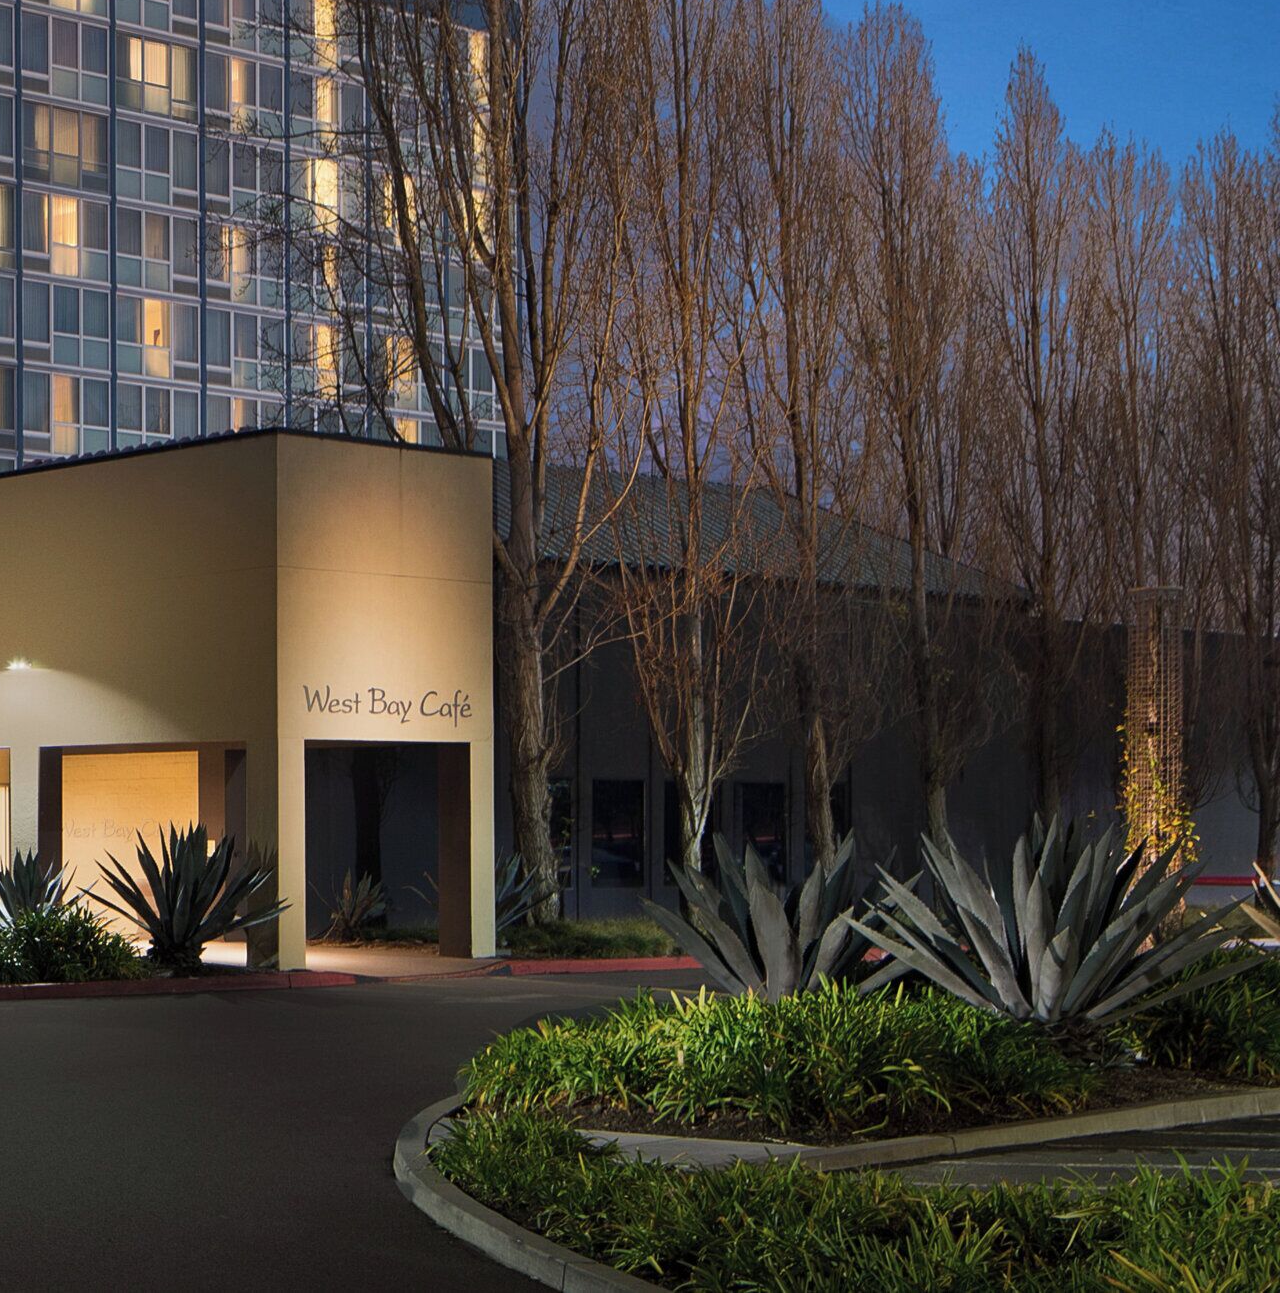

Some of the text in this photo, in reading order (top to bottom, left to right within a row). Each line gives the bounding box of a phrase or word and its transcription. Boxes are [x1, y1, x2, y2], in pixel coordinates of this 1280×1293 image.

[302, 684, 473, 728] West Bay Café
